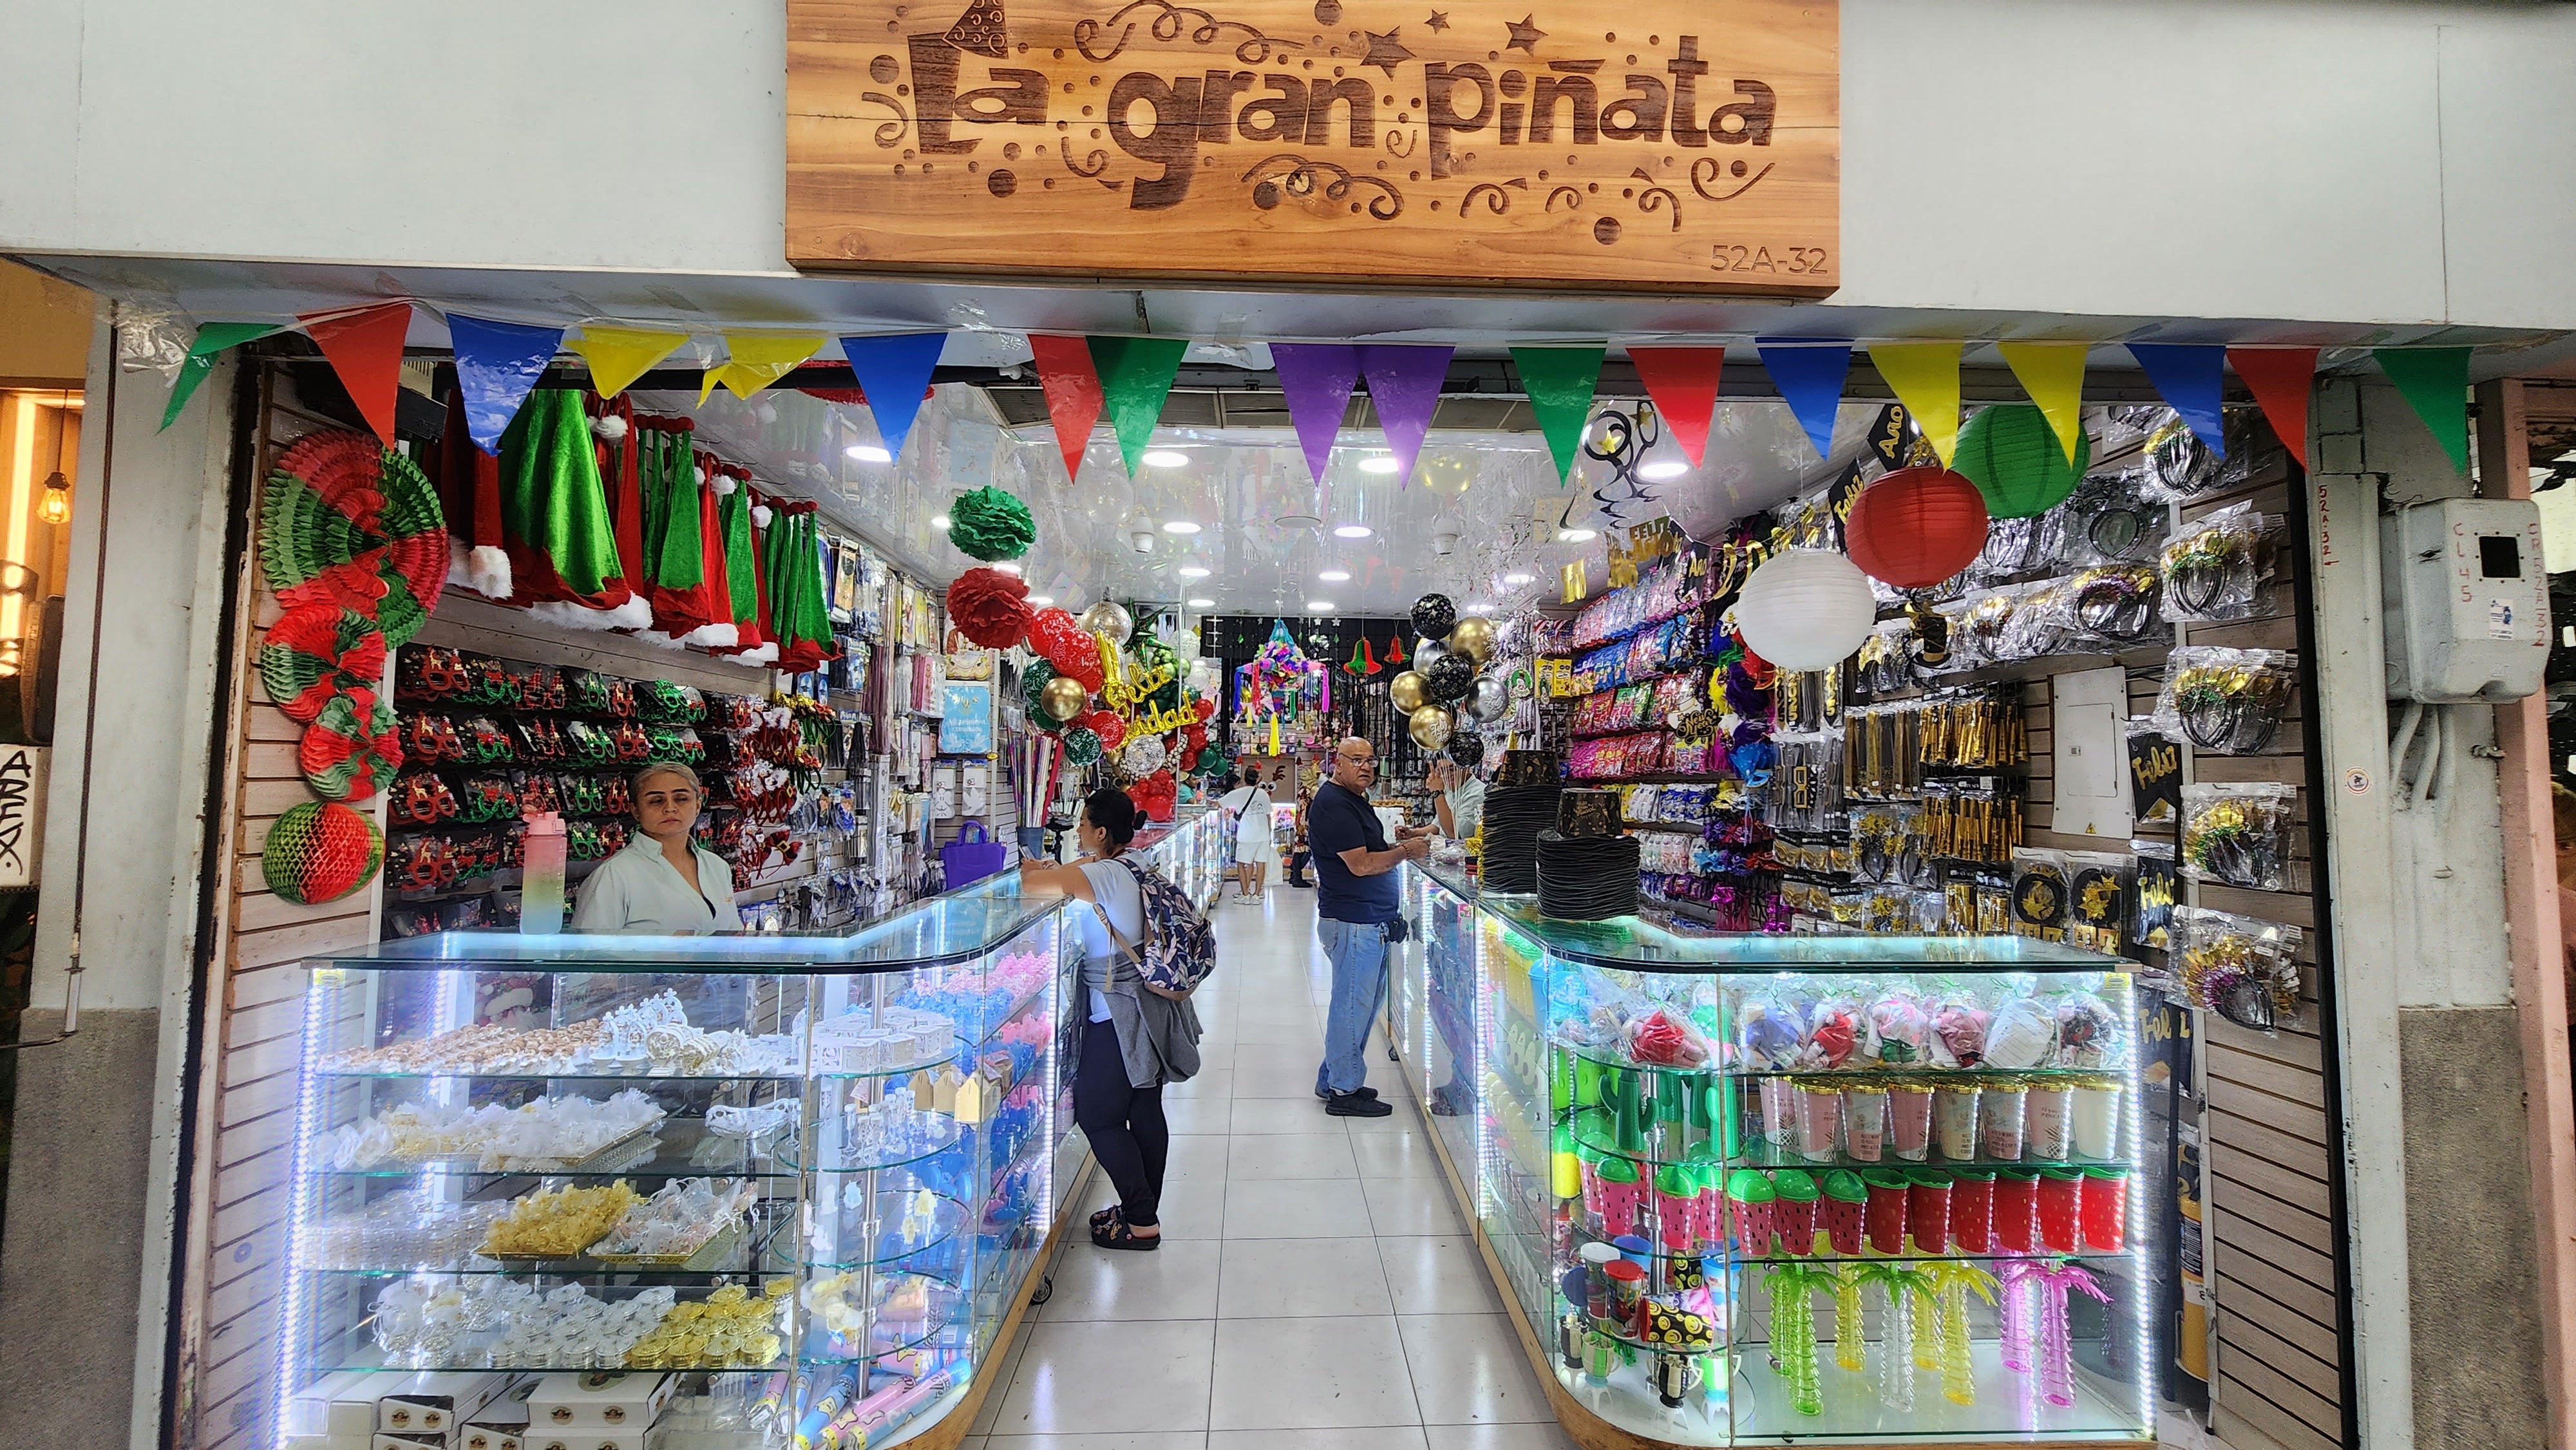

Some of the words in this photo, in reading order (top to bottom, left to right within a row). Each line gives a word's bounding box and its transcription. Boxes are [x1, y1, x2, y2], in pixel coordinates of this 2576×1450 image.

[907, 32, 1050, 154] La
[1108, 70, 1376, 211] gran
[1425, 35, 1776, 181] piñata
[1710, 245, 1828, 274] 52A-32
[1788, 673, 1798, 720] 2025
[2132, 746, 2177, 790] Feliz
